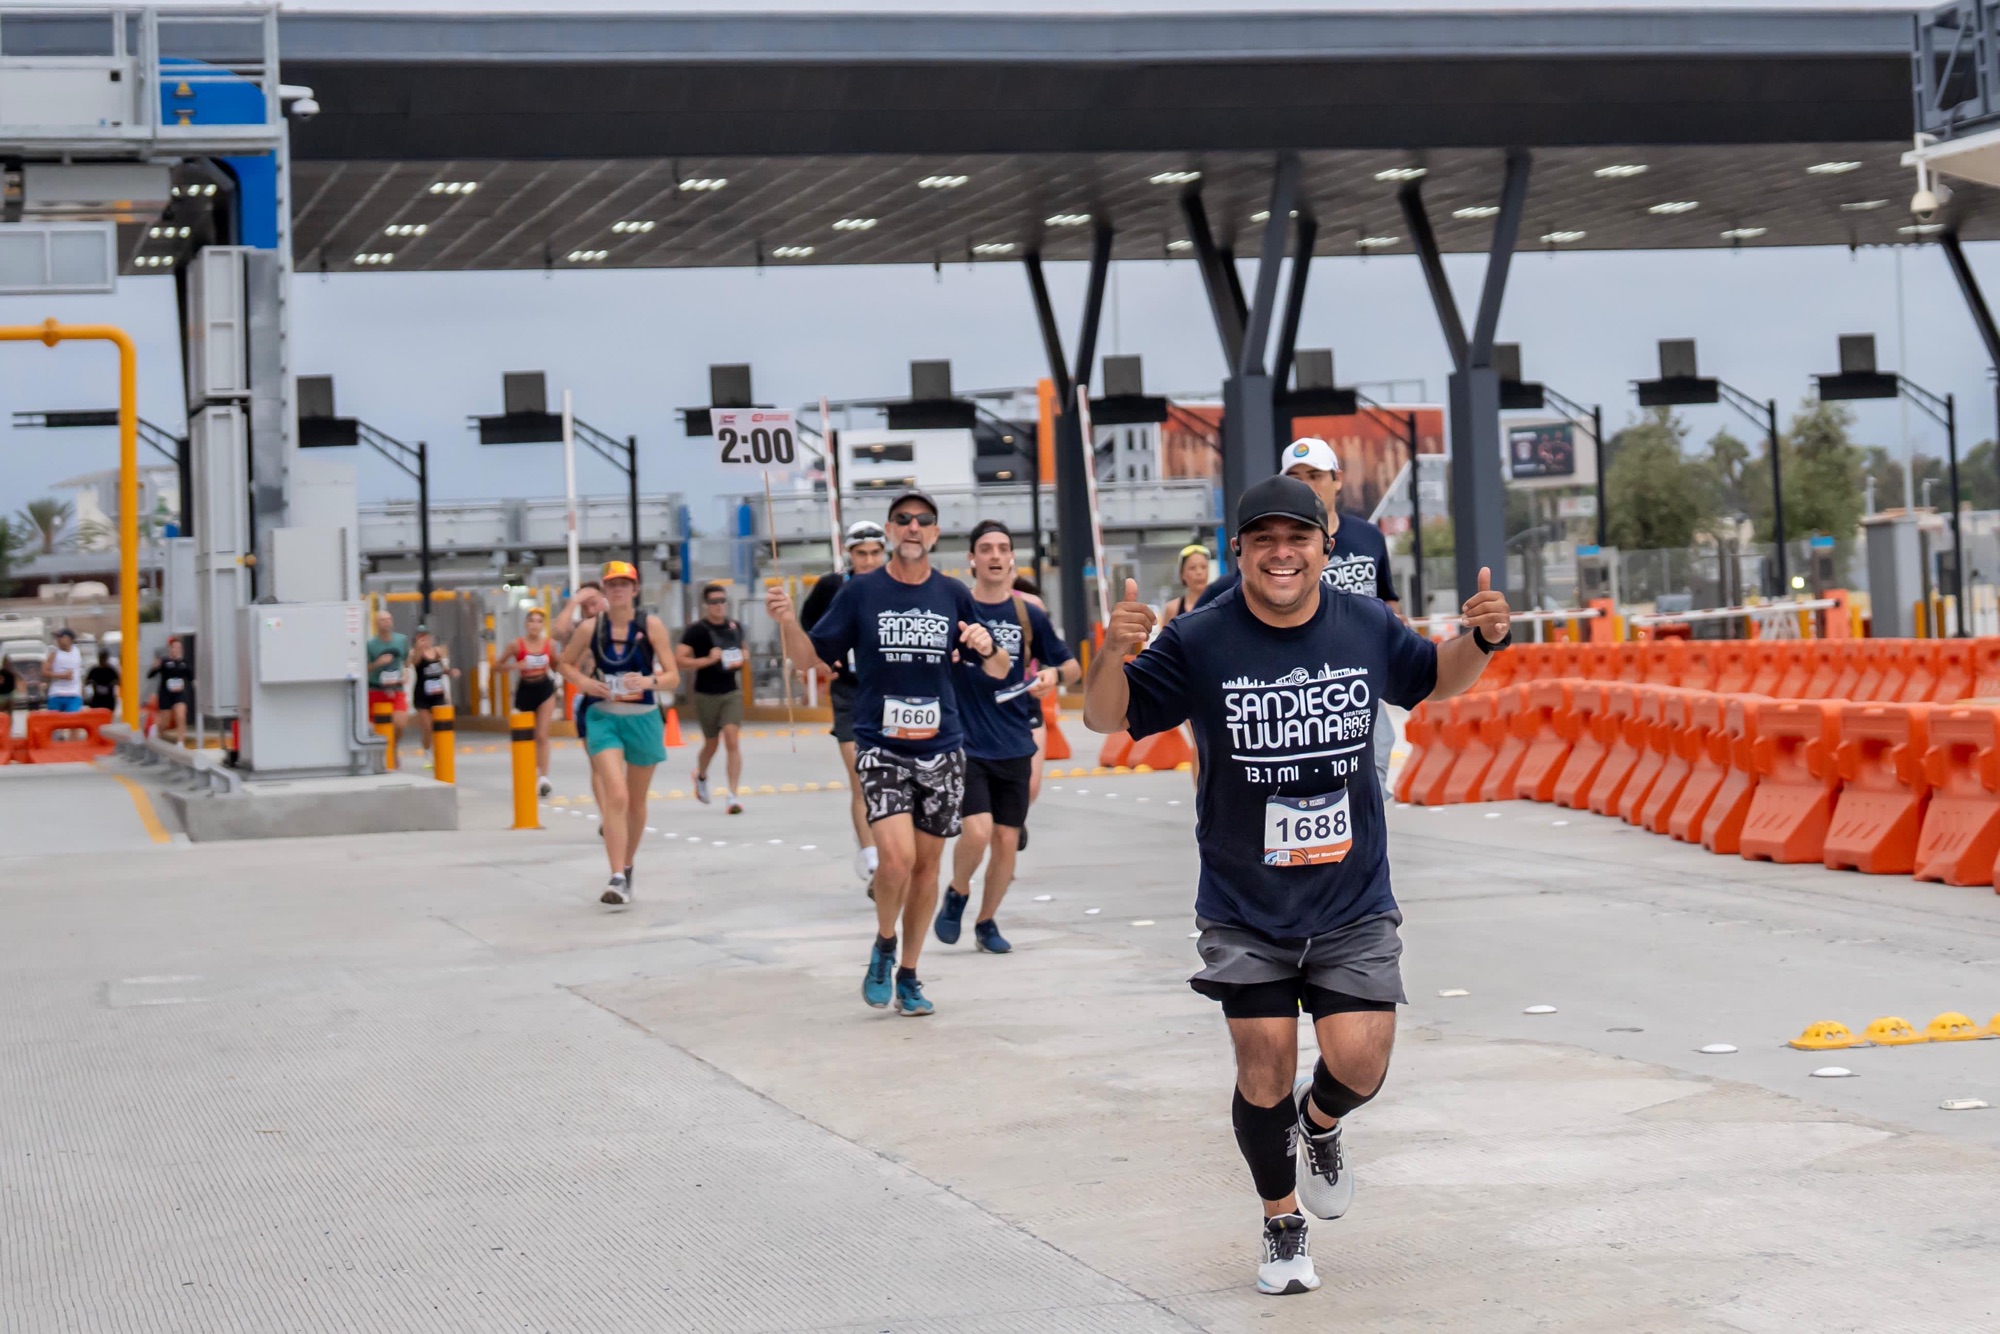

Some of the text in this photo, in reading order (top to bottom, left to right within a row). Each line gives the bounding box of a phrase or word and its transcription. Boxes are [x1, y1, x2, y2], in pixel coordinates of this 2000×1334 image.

[718, 427, 794, 464] 2:00
[1320, 563, 1376, 586] NDIEGO
[878, 631, 934, 647] TIJUANA
[891, 708, 935, 725] 1660
[1343, 714, 1371, 731] RACE
[1226, 714, 1342, 749] TIJUANA
[1343, 727, 1368, 740] 2024
[1244, 756, 1358, 783] 13.1 MI 10 K
[1276, 810, 1347, 842] 1688
